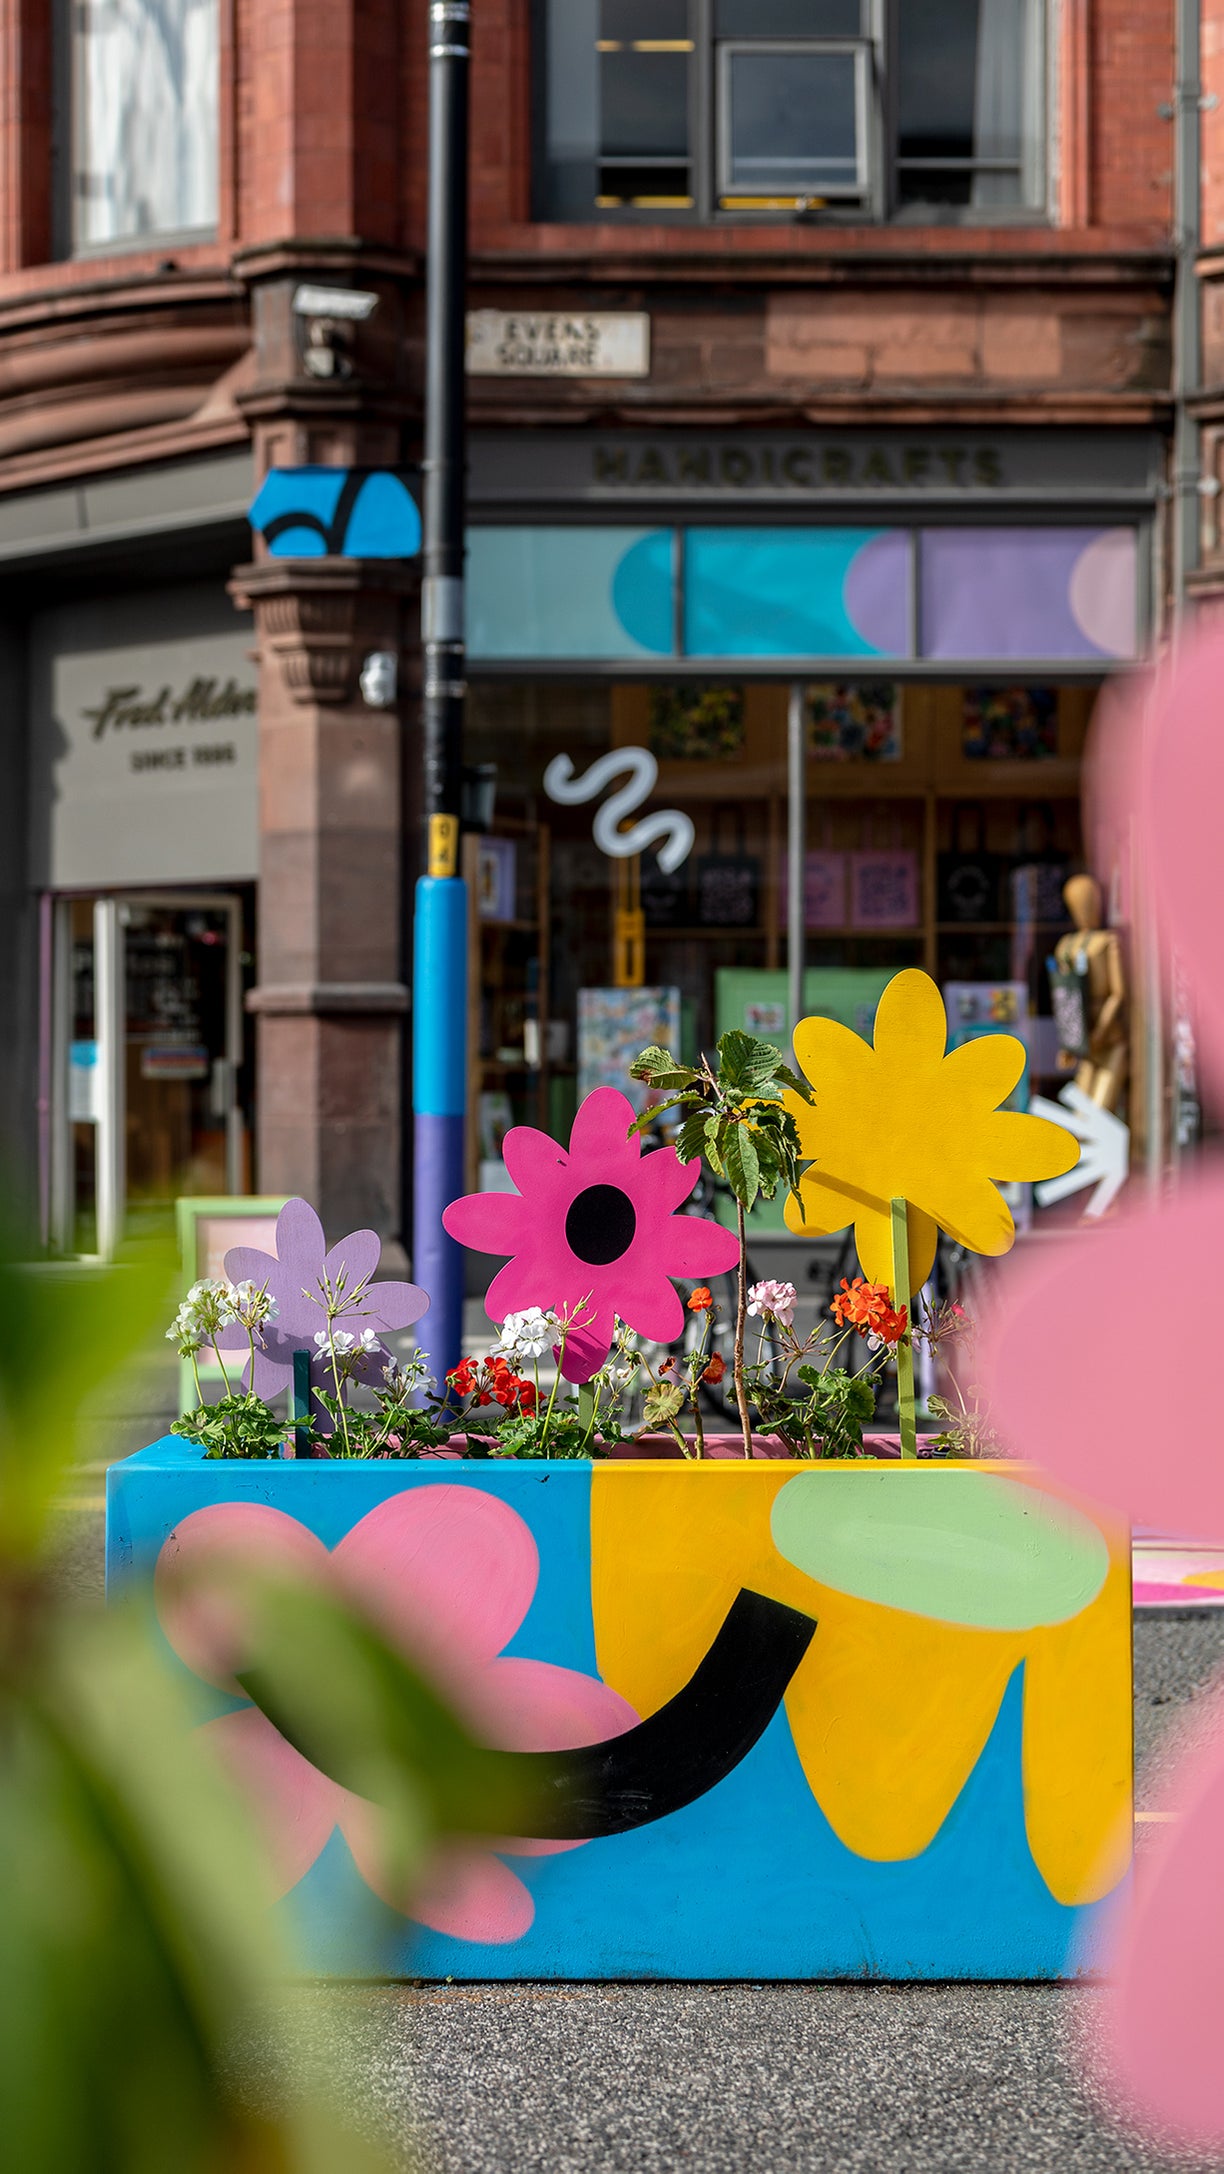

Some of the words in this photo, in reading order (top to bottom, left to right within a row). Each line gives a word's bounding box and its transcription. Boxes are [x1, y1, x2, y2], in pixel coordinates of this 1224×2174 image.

[497, 343, 595, 366] SQUARE
[593, 446, 1004, 486] HANDICRAFTS
[80, 684, 172, 740] Fred
[130, 748, 186, 772] SINCE
